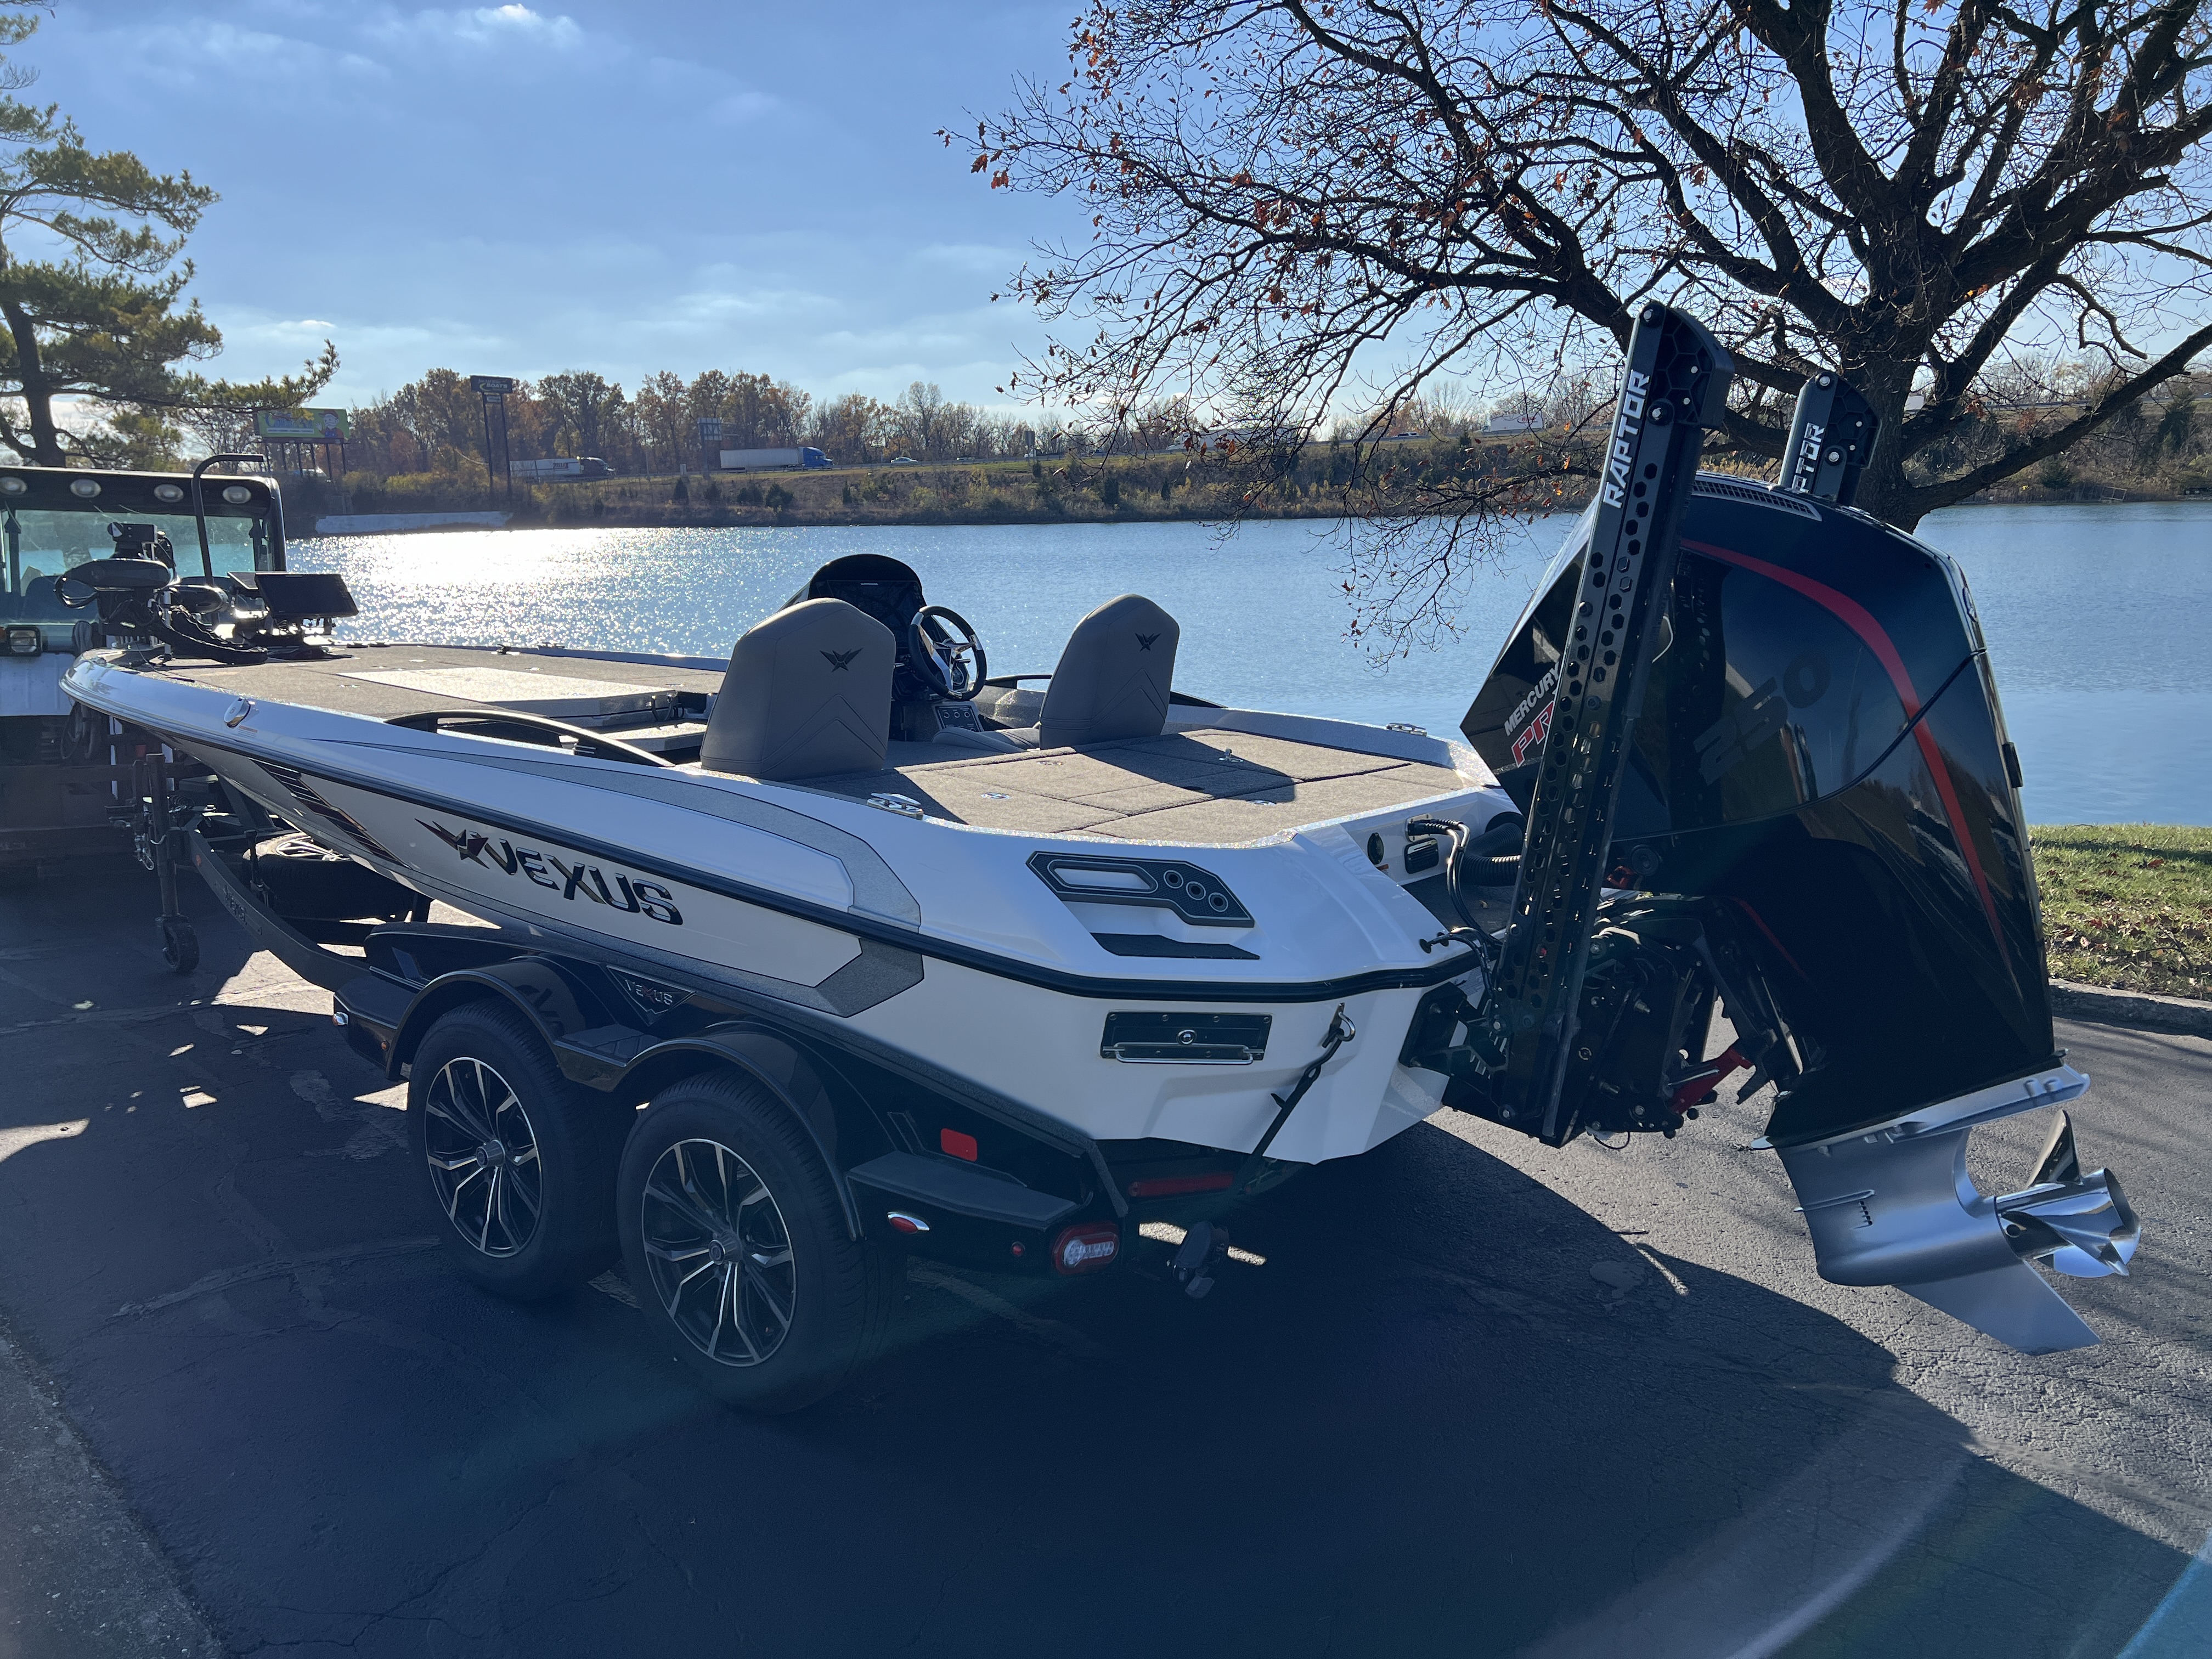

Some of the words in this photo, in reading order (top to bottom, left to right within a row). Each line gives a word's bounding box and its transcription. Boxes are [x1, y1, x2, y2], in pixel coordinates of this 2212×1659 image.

[1602, 369, 1650, 509] RAPTOR
[1791, 422, 1825, 494] PTOR
[1504, 662, 1559, 736] MERCURY
[1511, 700, 1555, 768] PR
[1693, 649, 1831, 786] 250
[469, 830, 683, 926] VEXUS
[624, 979, 673, 1005] VEXUS
